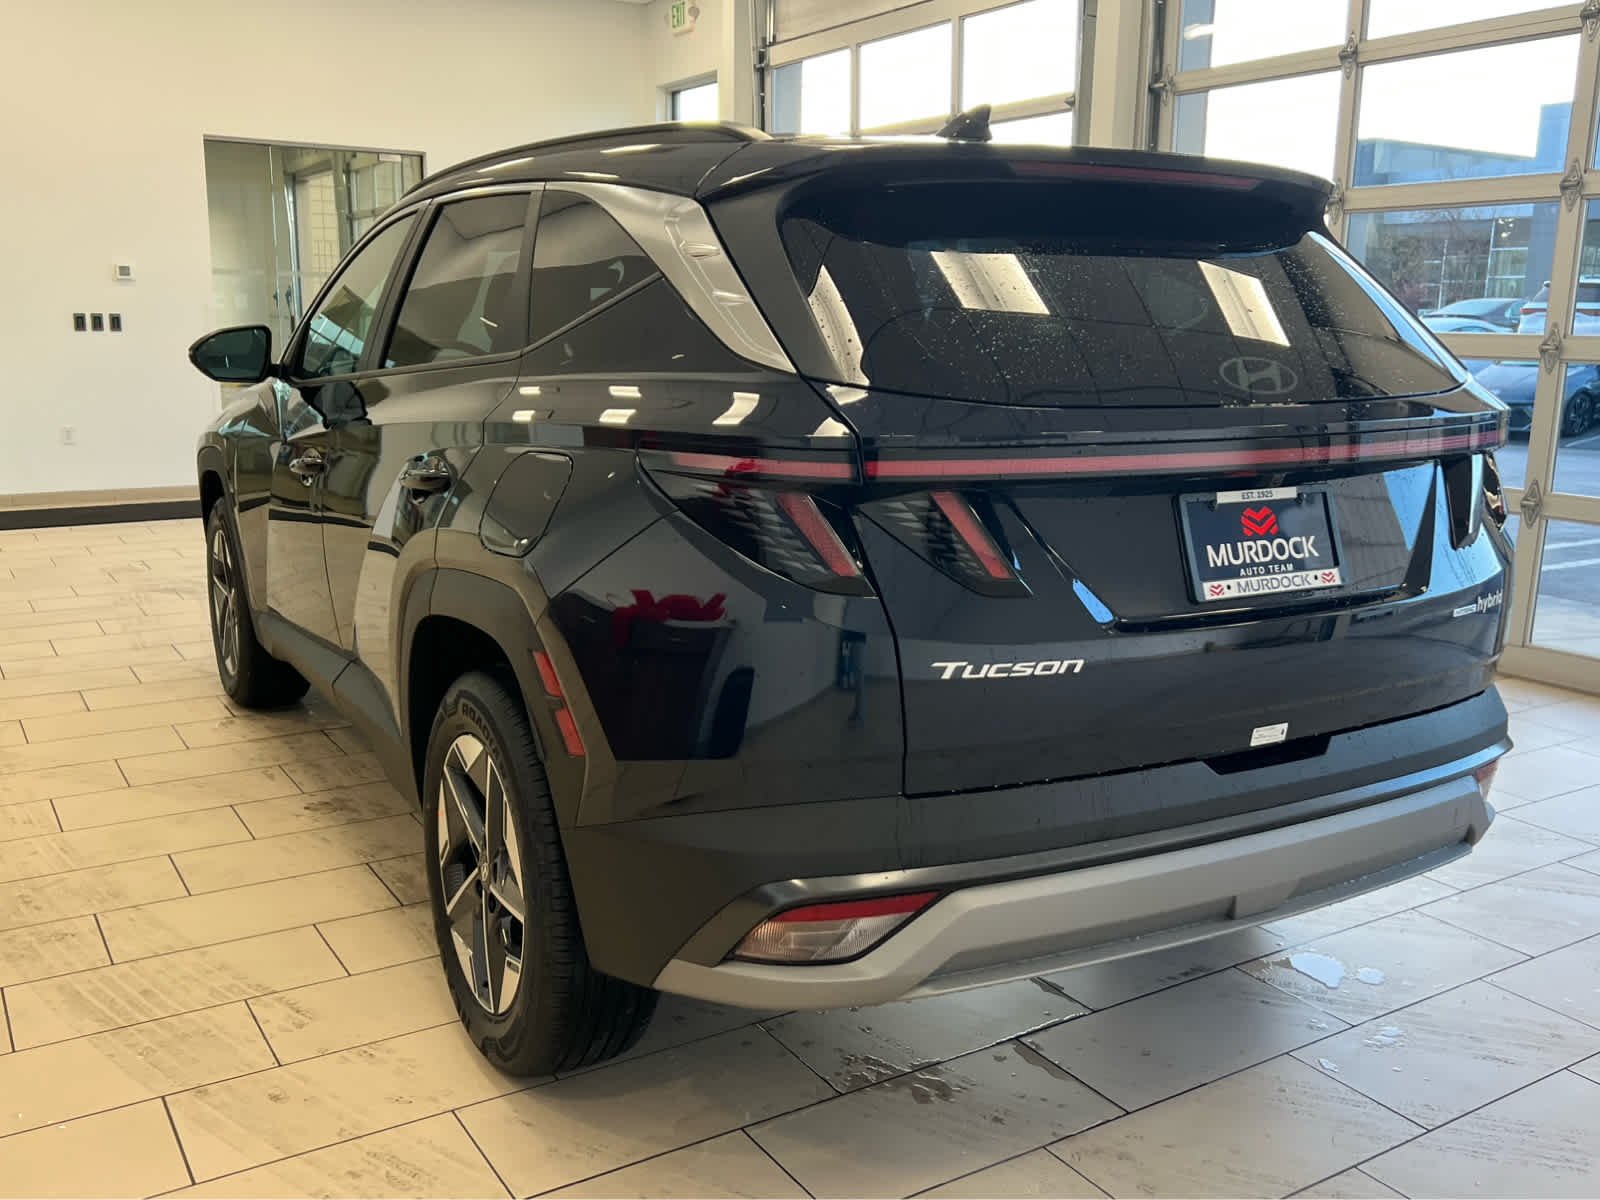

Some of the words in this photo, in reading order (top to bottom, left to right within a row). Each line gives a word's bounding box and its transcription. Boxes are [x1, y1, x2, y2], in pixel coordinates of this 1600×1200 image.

[672, 2, 686, 28] EXIT
[1206, 535, 1320, 567] MURDOCK
[1240, 566, 1265, 577] AUTO
[1268, 563, 1294, 574] TEAM
[1236, 574, 1312, 593] MURDOCK
[1477, 589, 1503, 613] hybrid
